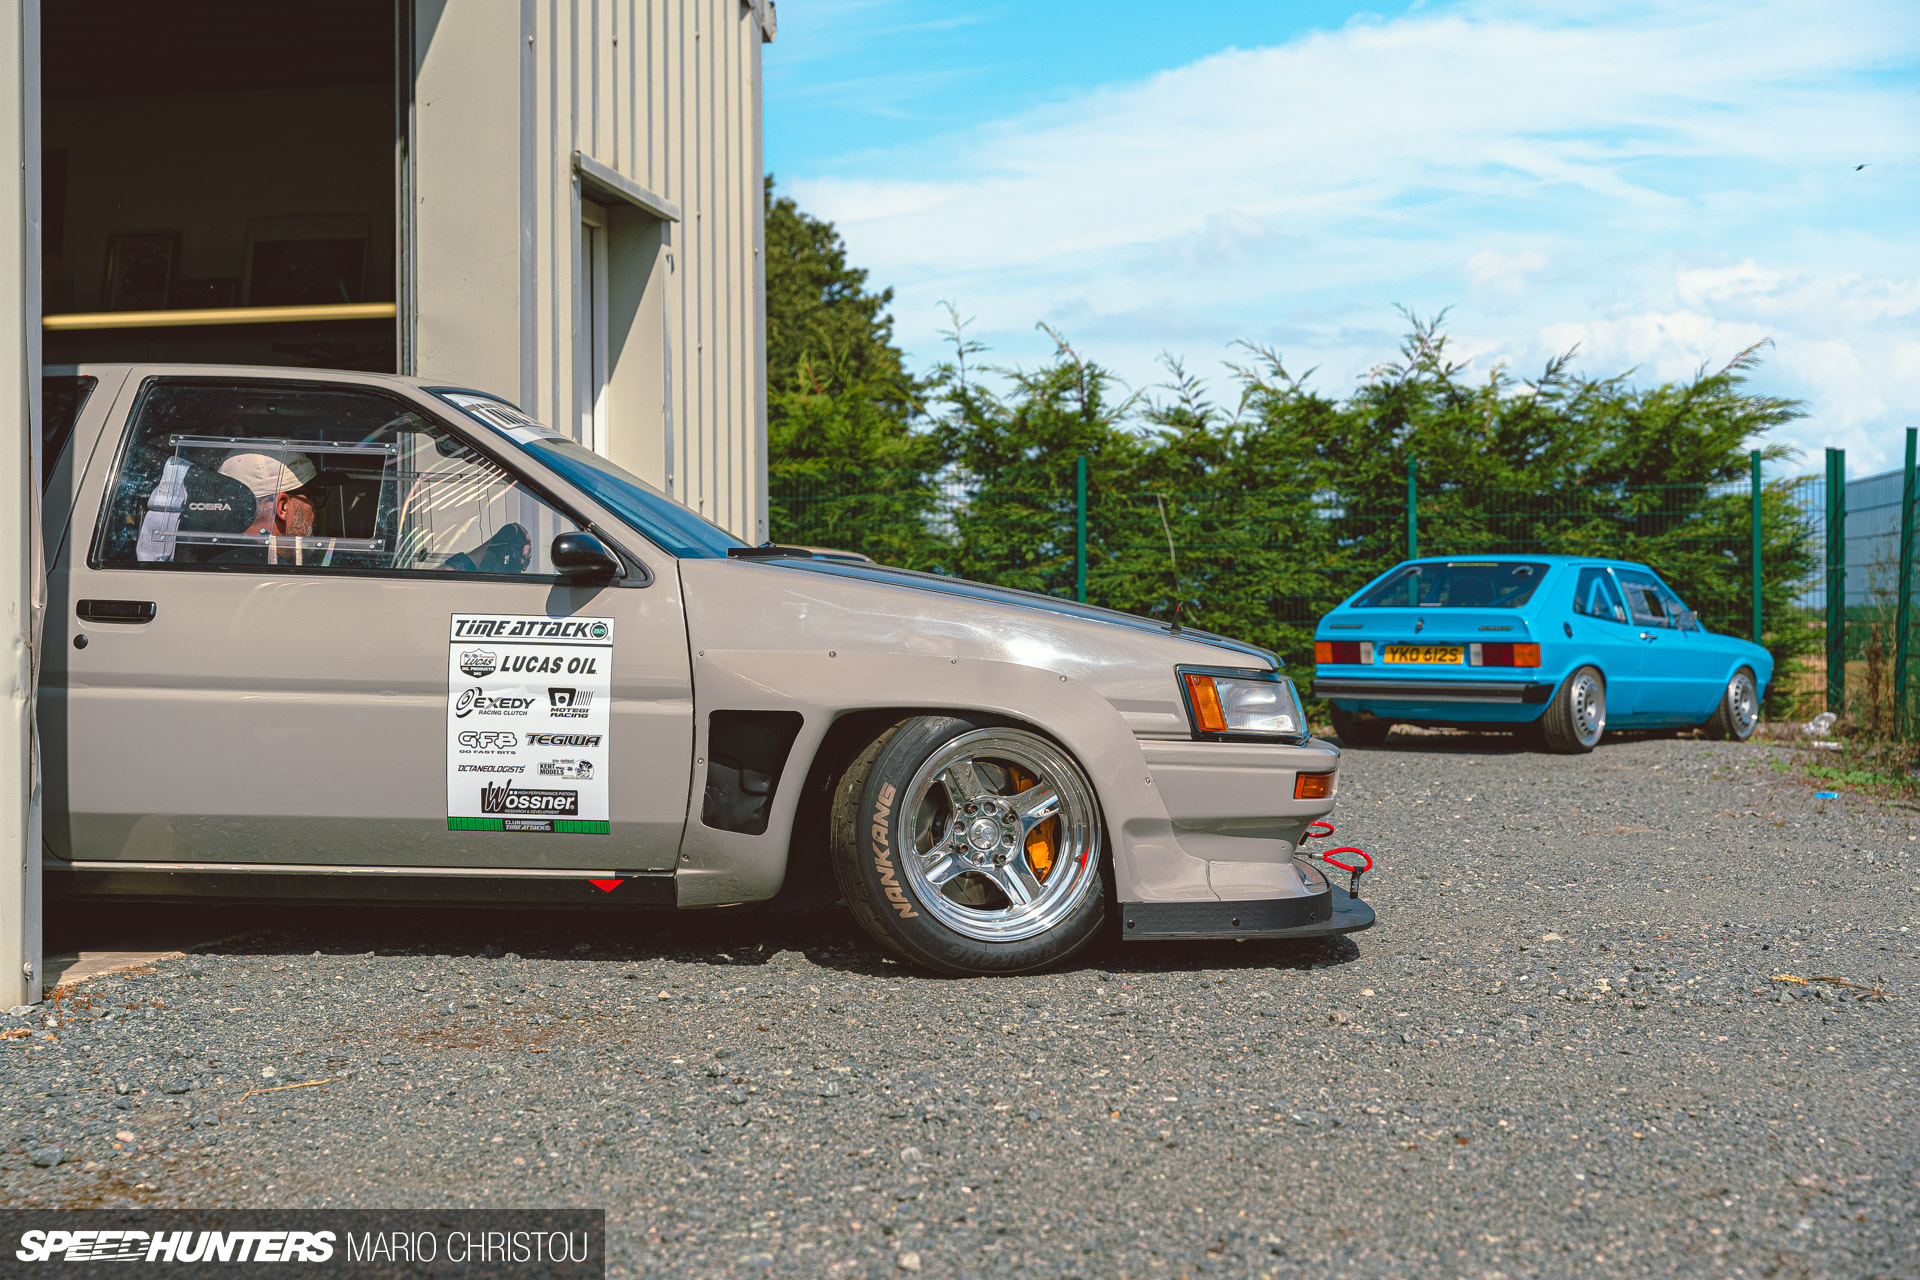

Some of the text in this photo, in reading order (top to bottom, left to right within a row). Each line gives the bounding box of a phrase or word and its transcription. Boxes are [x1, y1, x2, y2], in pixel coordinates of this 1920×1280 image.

[1389, 648, 1459, 662] YKO 612S
[500, 656, 598, 674] LUCAS OIL
[474, 697, 536, 709] EXEDY
[458, 731, 518, 749] GFB
[525, 732, 603, 747] TEGIWA
[458, 765, 526, 773] OCTANEOLOGISTS
[872, 781, 919, 918] NANKANG
